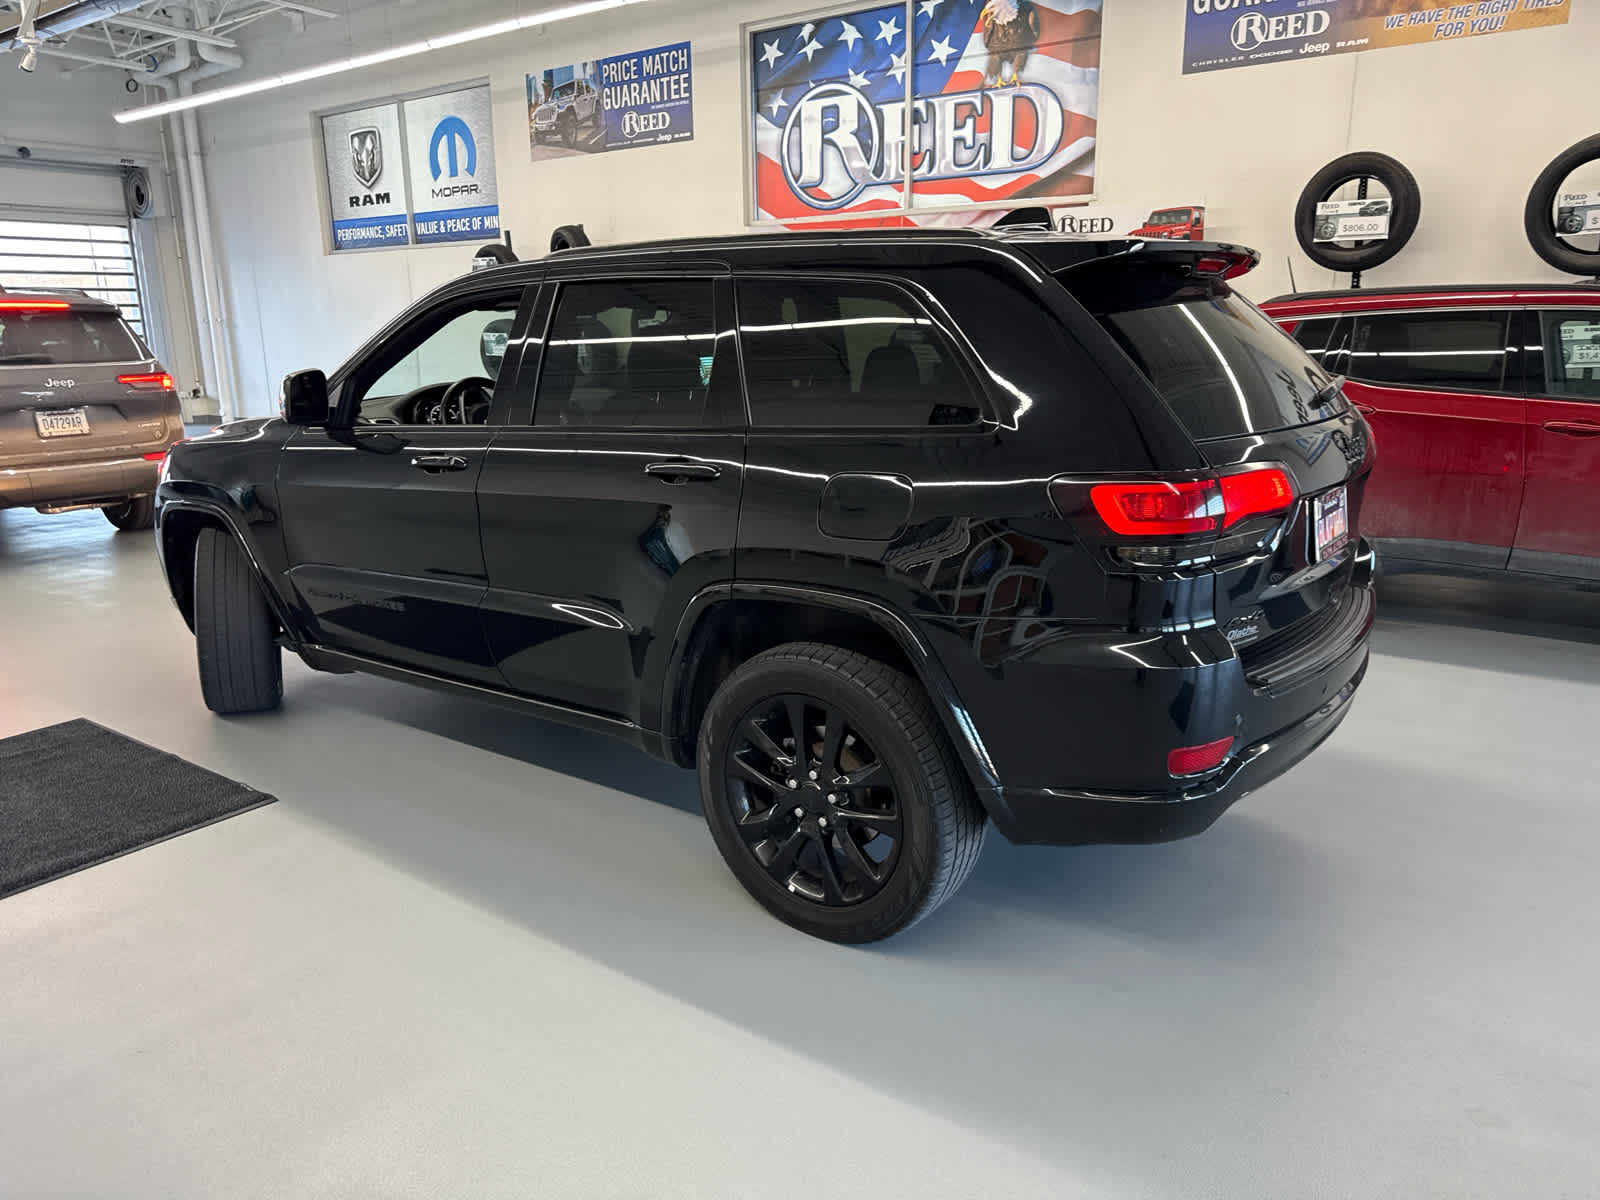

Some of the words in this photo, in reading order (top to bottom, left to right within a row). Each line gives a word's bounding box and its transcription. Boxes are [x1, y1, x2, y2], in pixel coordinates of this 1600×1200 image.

[1384, 14, 1406, 29] WE
[1407, 8, 1443, 25] HAVE
[1447, 4, 1473, 19] THE
[1476, 0, 1517, 16] RIGHT
[1230, 10, 1330, 51] REED
[1433, 22, 1465, 38] FOR
[1469, 15, 1506, 33] YOU!
[1192, 55, 1245, 67] CHRYSLER
[1249, 49, 1294, 59] DODGE
[1299, 41, 1330, 54] Jeep
[1336, 38, 1369, 48] RAM
[602, 58, 638, 85] PRICE
[642, 48, 688, 77] MATCH
[603, 73, 690, 110] GUARANTEE
[621, 111, 671, 138] REED
[781, 81, 1064, 210] REED
[349, 192, 391, 207] RAM
[431, 184, 480, 199] MOPAR
[337, 227, 385, 241] PERFORMANCE,
[416, 220, 439, 235] VALUE
[439, 221, 446, 233] &
[447, 218, 470, 232] PEACE
[472, 216, 482, 230] OF
[484, 215, 499, 229] MIN
[1058, 214, 1114, 233] REED
[1342, 223, 1379, 233] $806.00
[44, 378, 75, 388] Jeep
